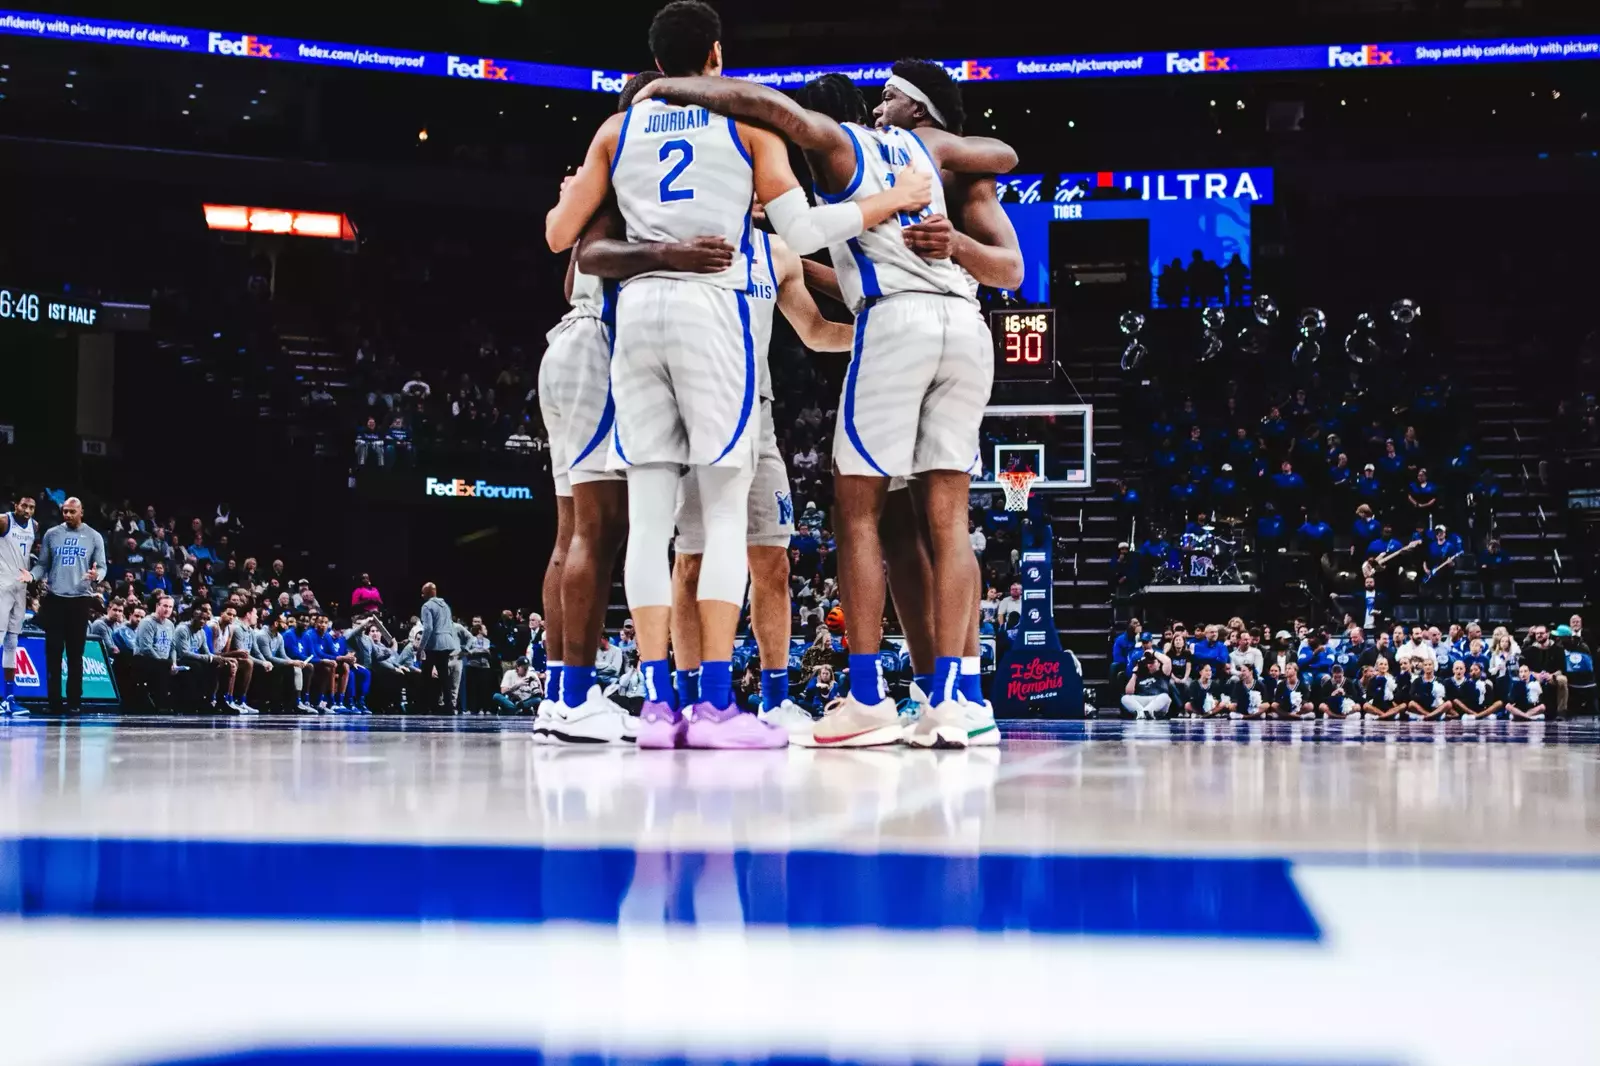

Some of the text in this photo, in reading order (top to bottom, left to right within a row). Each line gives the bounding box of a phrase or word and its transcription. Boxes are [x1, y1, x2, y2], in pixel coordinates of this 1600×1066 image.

[46, 20, 69, 33] with
[70, 22, 106, 37] picture
[107, 27, 135, 40] proof
[136, 31, 148, 41] of
[148, 30, 190, 48] delivery.
[208, 31, 272, 58] FedEx
[298, 43, 425, 68] fedex.com/pictureproof
[1166, 51, 1230, 73] FedEx
[1328, 45, 1393, 68] FedEx
[1416, 41, 1599, 61] Shop and ship confidently with picture
[447, 55, 508, 81] FedEx
[783, 71, 804, 83] with
[863, 68, 875, 79] of
[1016, 56, 1144, 74] fedex.com/pictureproof
[591, 70, 637, 93] Fed
[644, 108, 710, 133] JOURDAIN
[658, 138, 695, 204] 2
[1053, 204, 1082, 219] TIGER
[68, 306, 97, 325] HALF
[1005, 314, 1047, 333] 16:46
[1006, 333, 1042, 362] 30
[55, 546, 88, 557] TIGERS
[64, 537, 79, 546] GO
[61, 556, 76, 566] GO
[1010, 657, 1060, 680] I Love
[1007, 675, 1063, 701] Memphis
